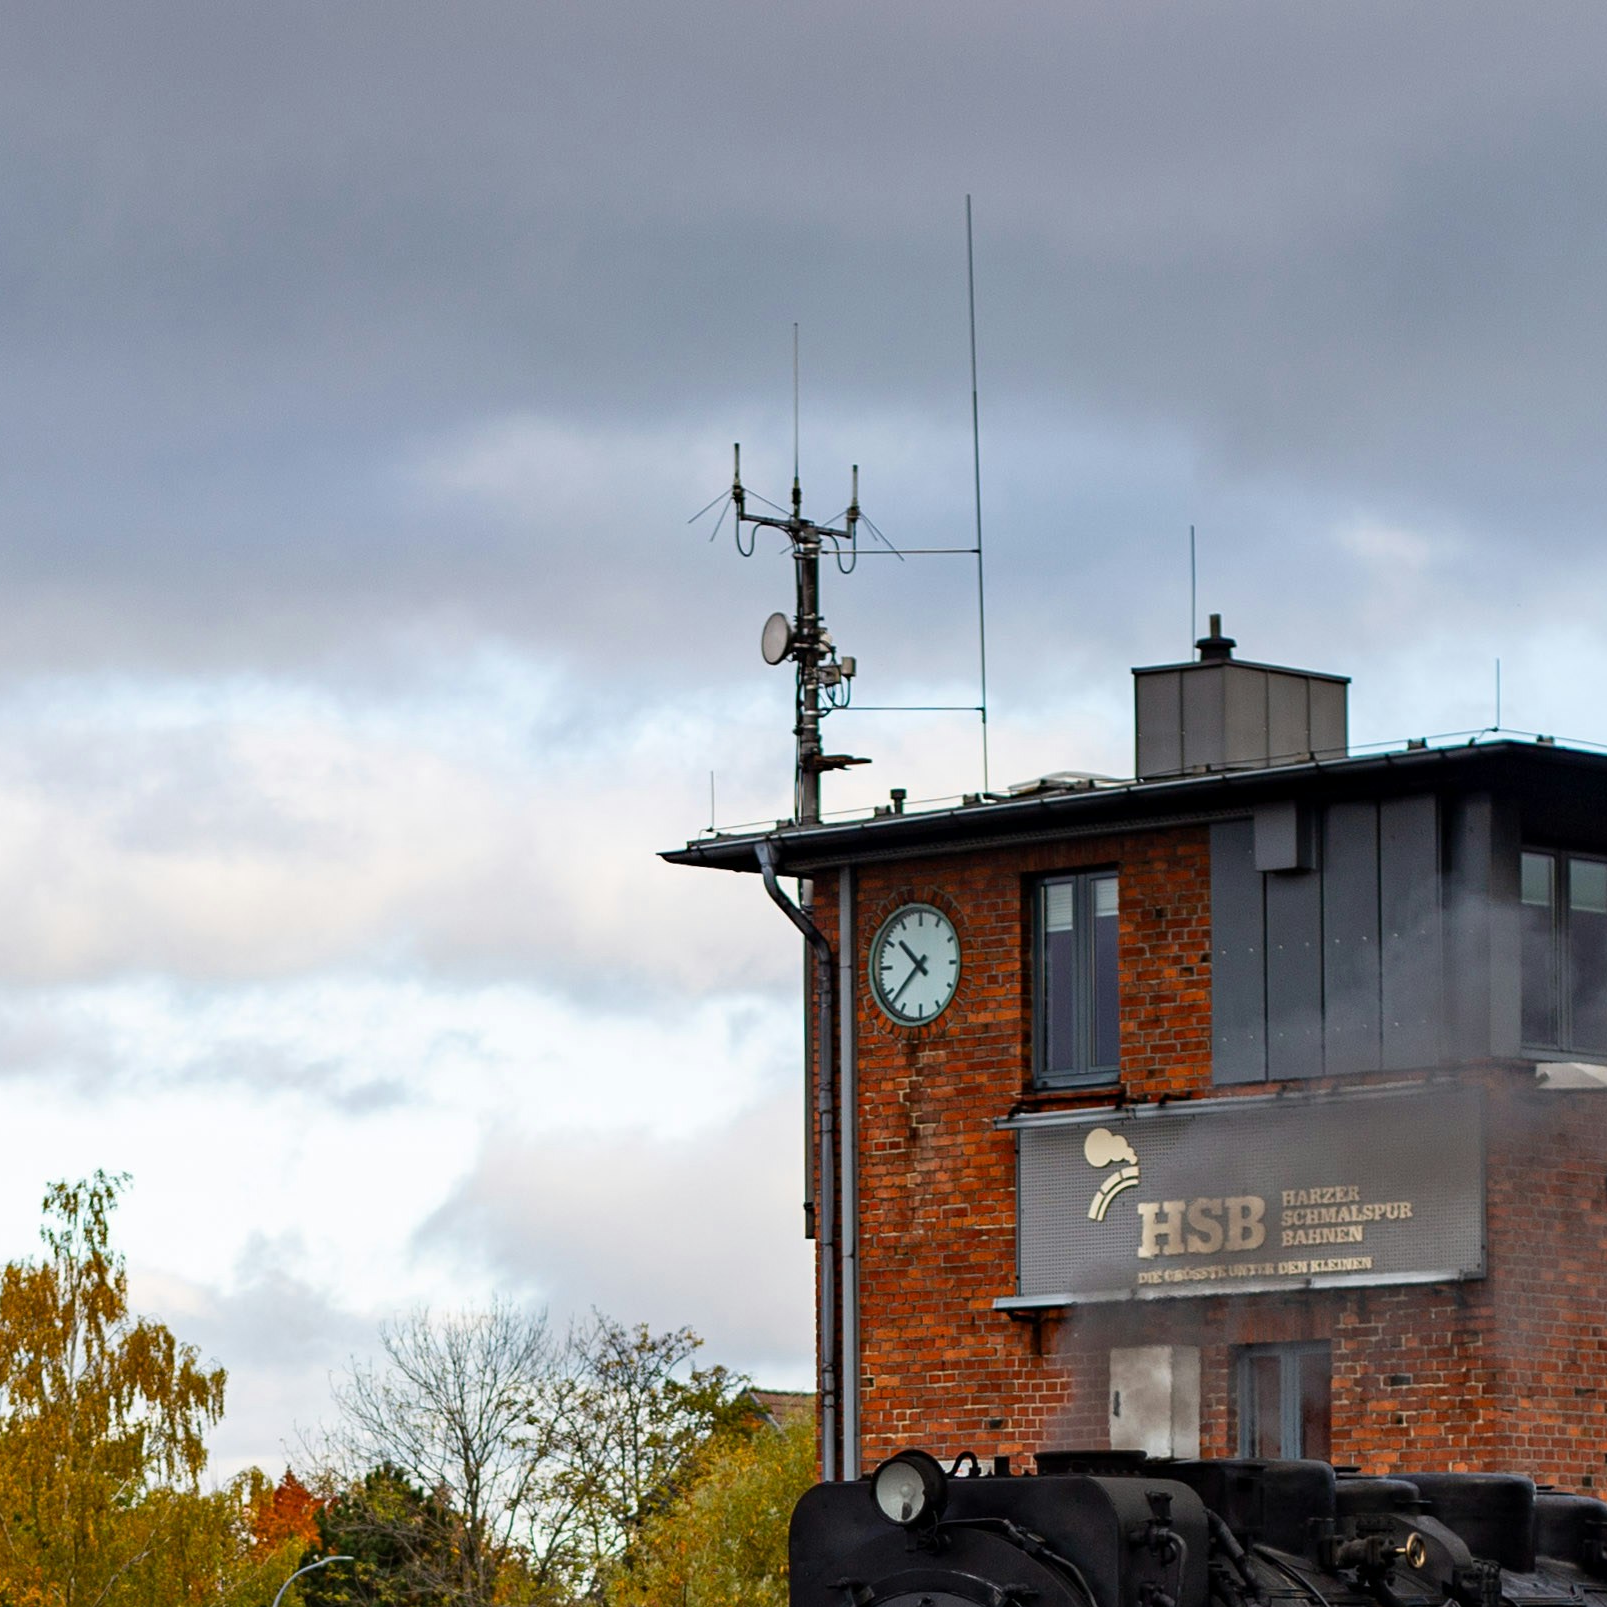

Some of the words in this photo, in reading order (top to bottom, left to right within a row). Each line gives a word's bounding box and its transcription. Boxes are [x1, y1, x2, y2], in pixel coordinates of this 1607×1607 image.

[1282, 1185, 1360, 1206] HARZER
[1282, 1202, 1413, 1226] SCHMALSPUR
[1138, 1195, 1266, 1258] HSB
[1282, 1225, 1363, 1247] BAHNEN
[1138, 1271, 1162, 1284] DIE
[1279, 1260, 1308, 1274] DEN
[1310, 1256, 1373, 1272] KLEINEN
